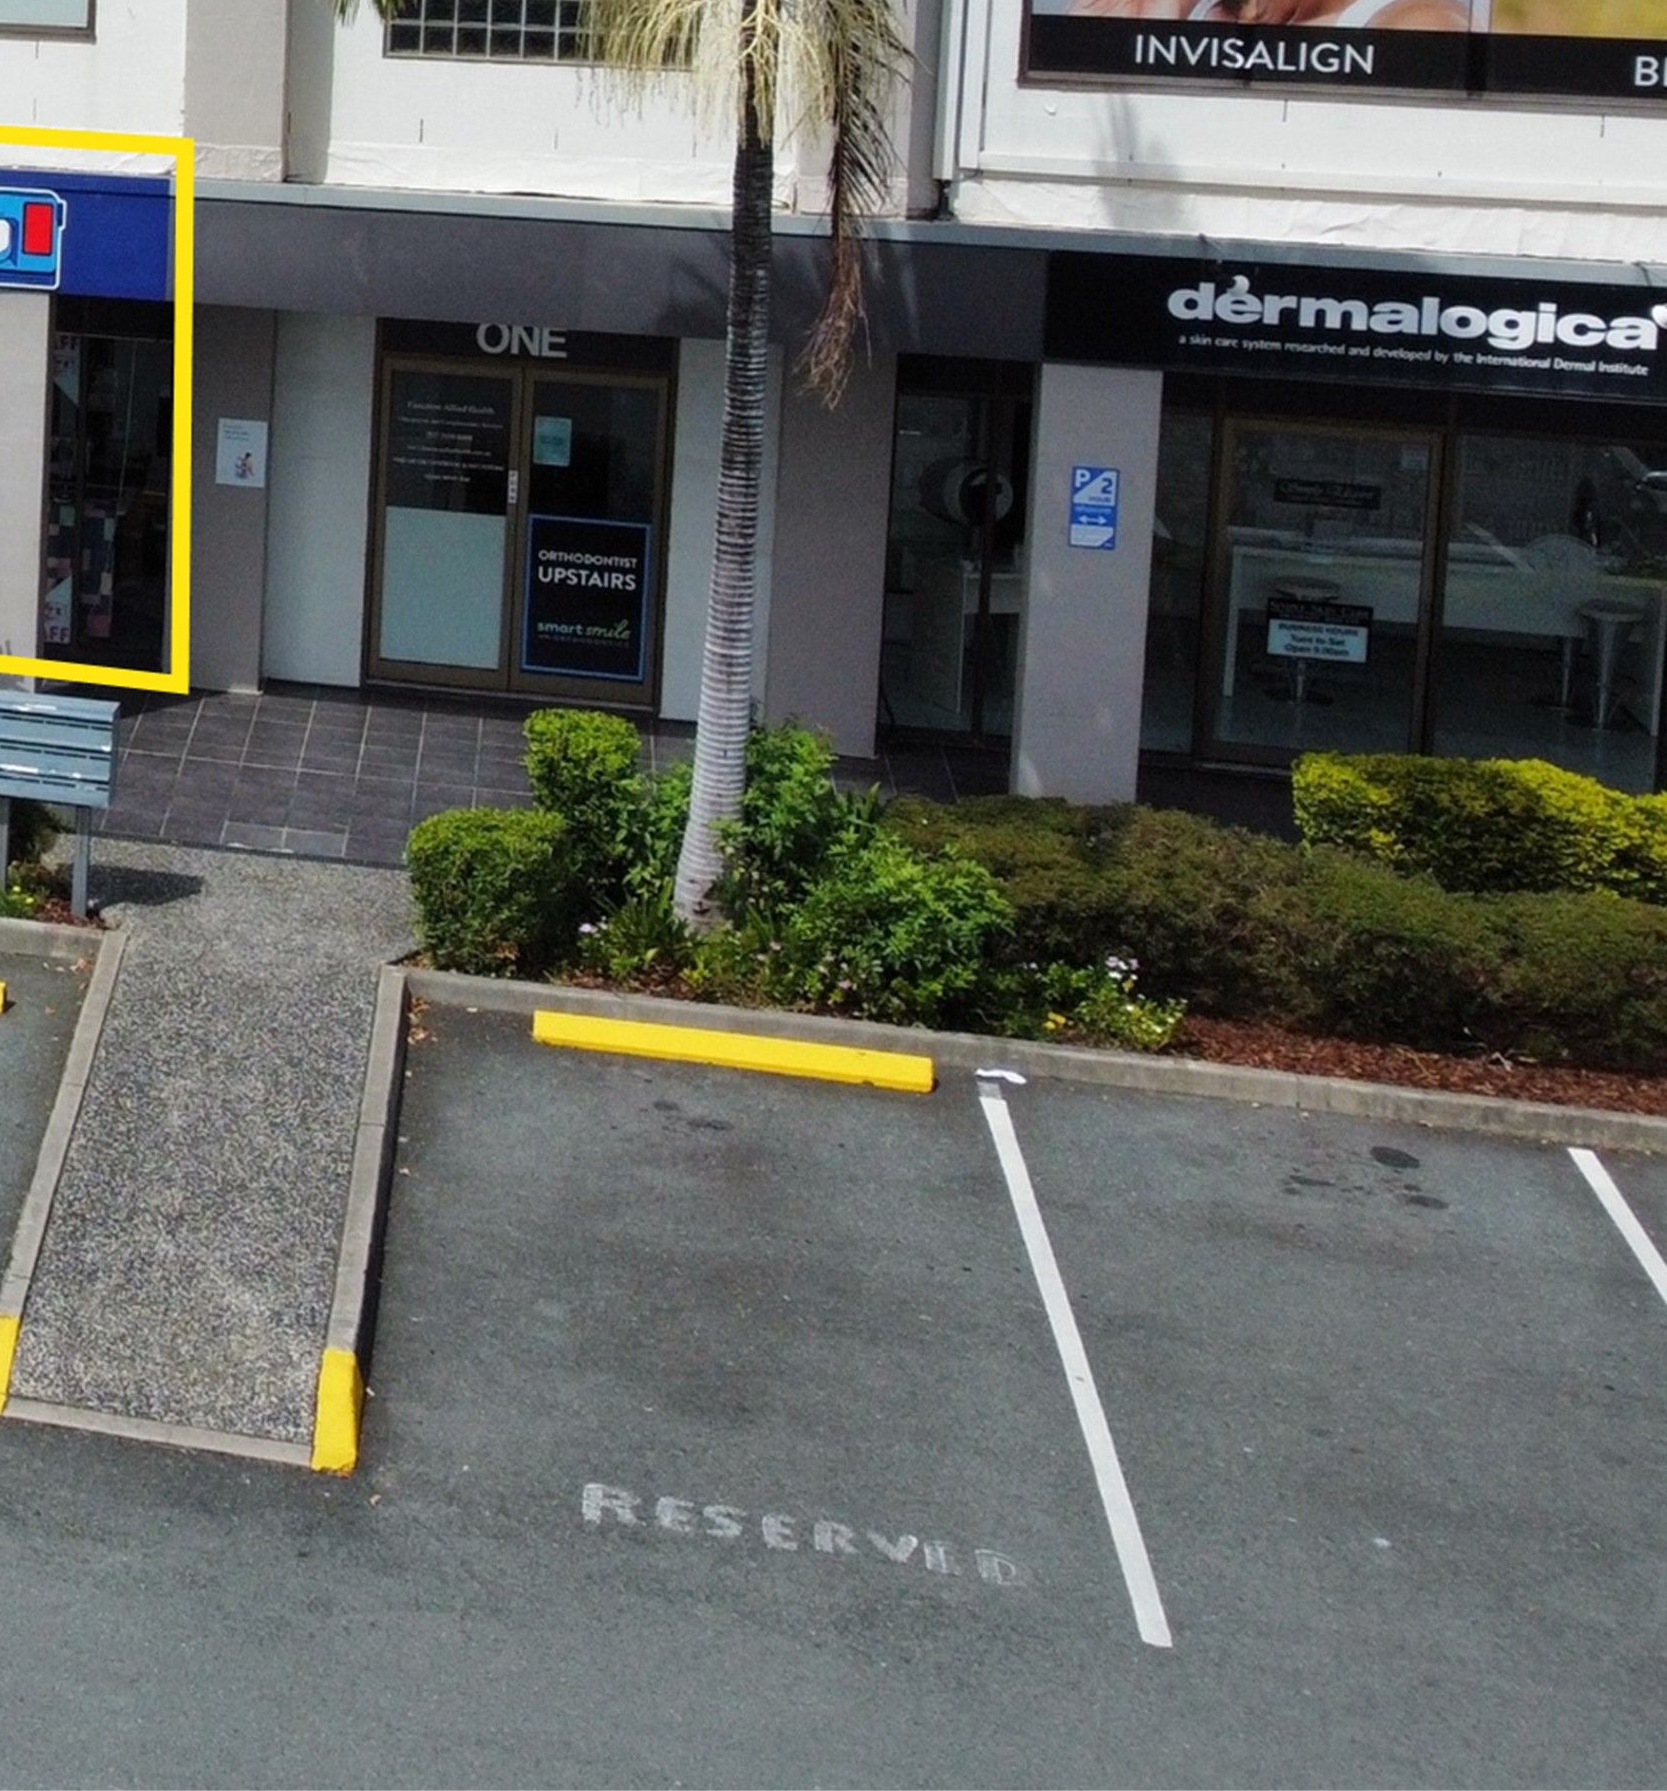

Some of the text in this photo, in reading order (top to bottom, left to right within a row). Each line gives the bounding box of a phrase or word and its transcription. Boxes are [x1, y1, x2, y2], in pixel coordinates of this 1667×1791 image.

[1134, 33, 1375, 75] INVISALIGN
[1167, 275, 1658, 351] dermalogica
[476, 323, 567, 359] ONE
[1179, 334, 1649, 377] a skin care system researched and developed by the International Dermal Institute
[1075, 469, 1091, 488] P
[1101, 477, 1113, 494] 2
[538, 549, 638, 569] ORTHODONTIST
[538, 565, 637, 591] UPSTAIRS
[537, 618, 631, 640] smart smile
